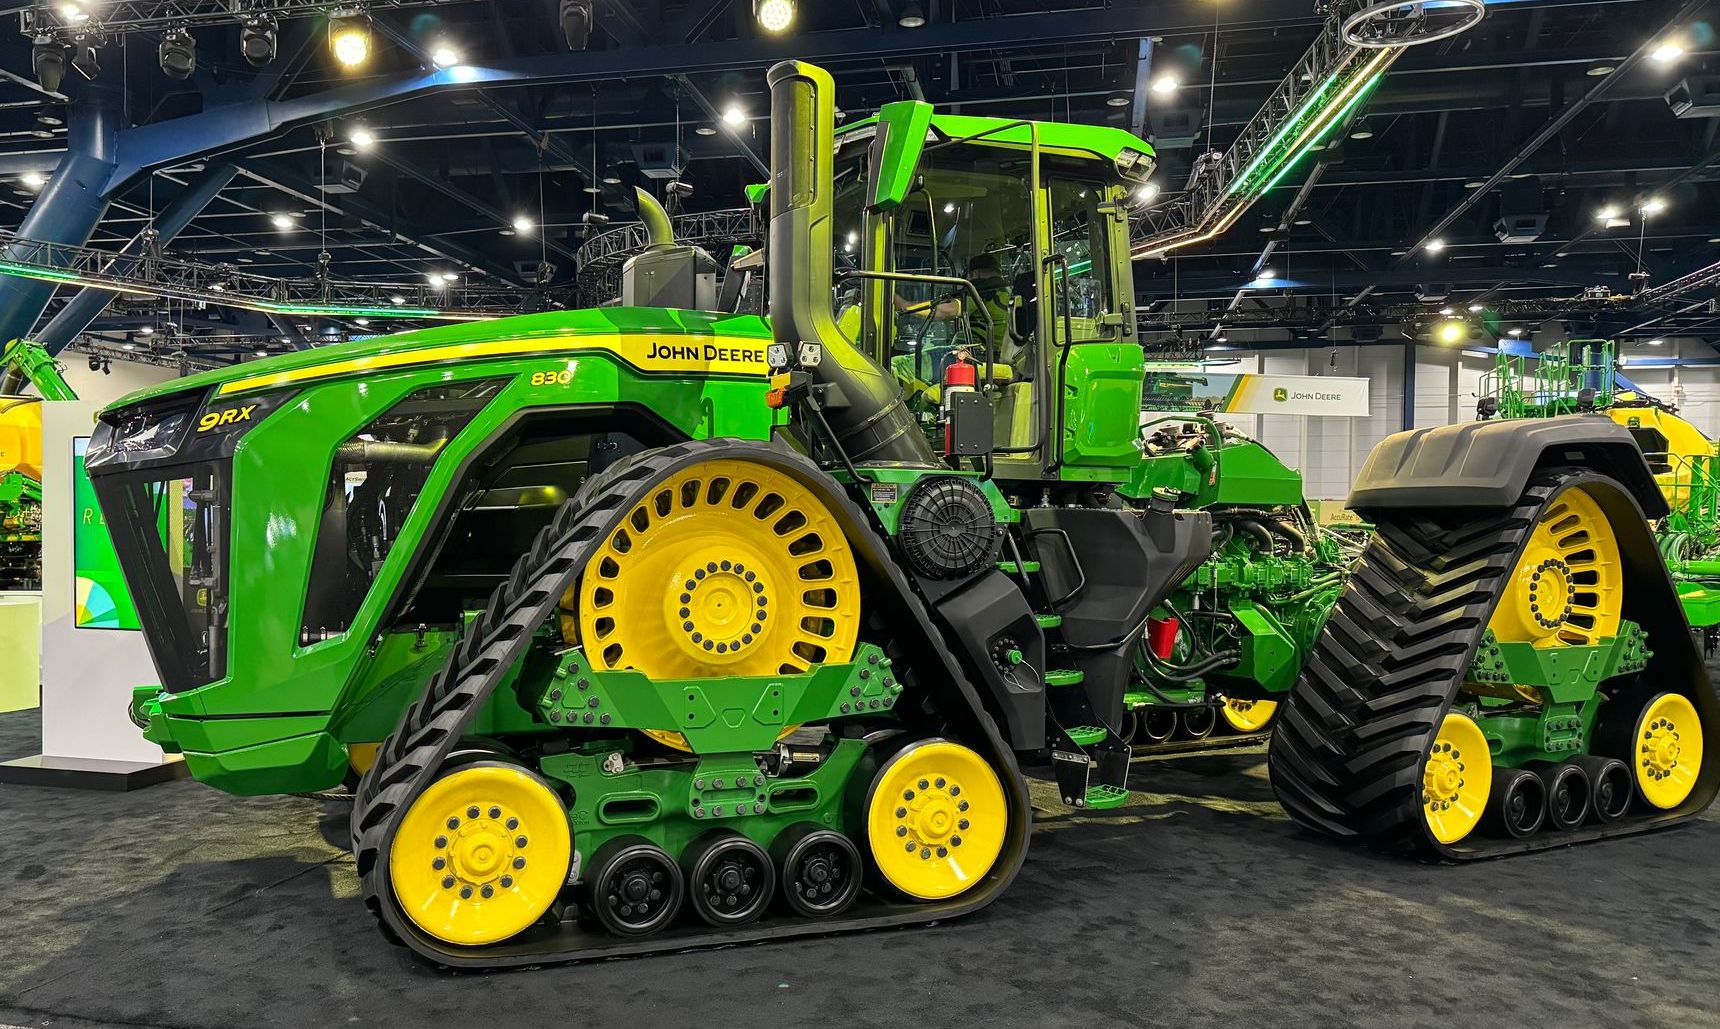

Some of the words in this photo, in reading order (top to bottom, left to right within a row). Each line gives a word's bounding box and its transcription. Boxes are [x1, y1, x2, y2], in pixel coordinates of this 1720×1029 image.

[646, 342, 699, 361] JOHN
[703, 344, 765, 363] DEERE
[530, 369, 572, 386] 830
[1291, 391, 1314, 400] JOHN
[1315, 392, 1341, 401] DEERE
[196, 404, 257, 432] 9RX
